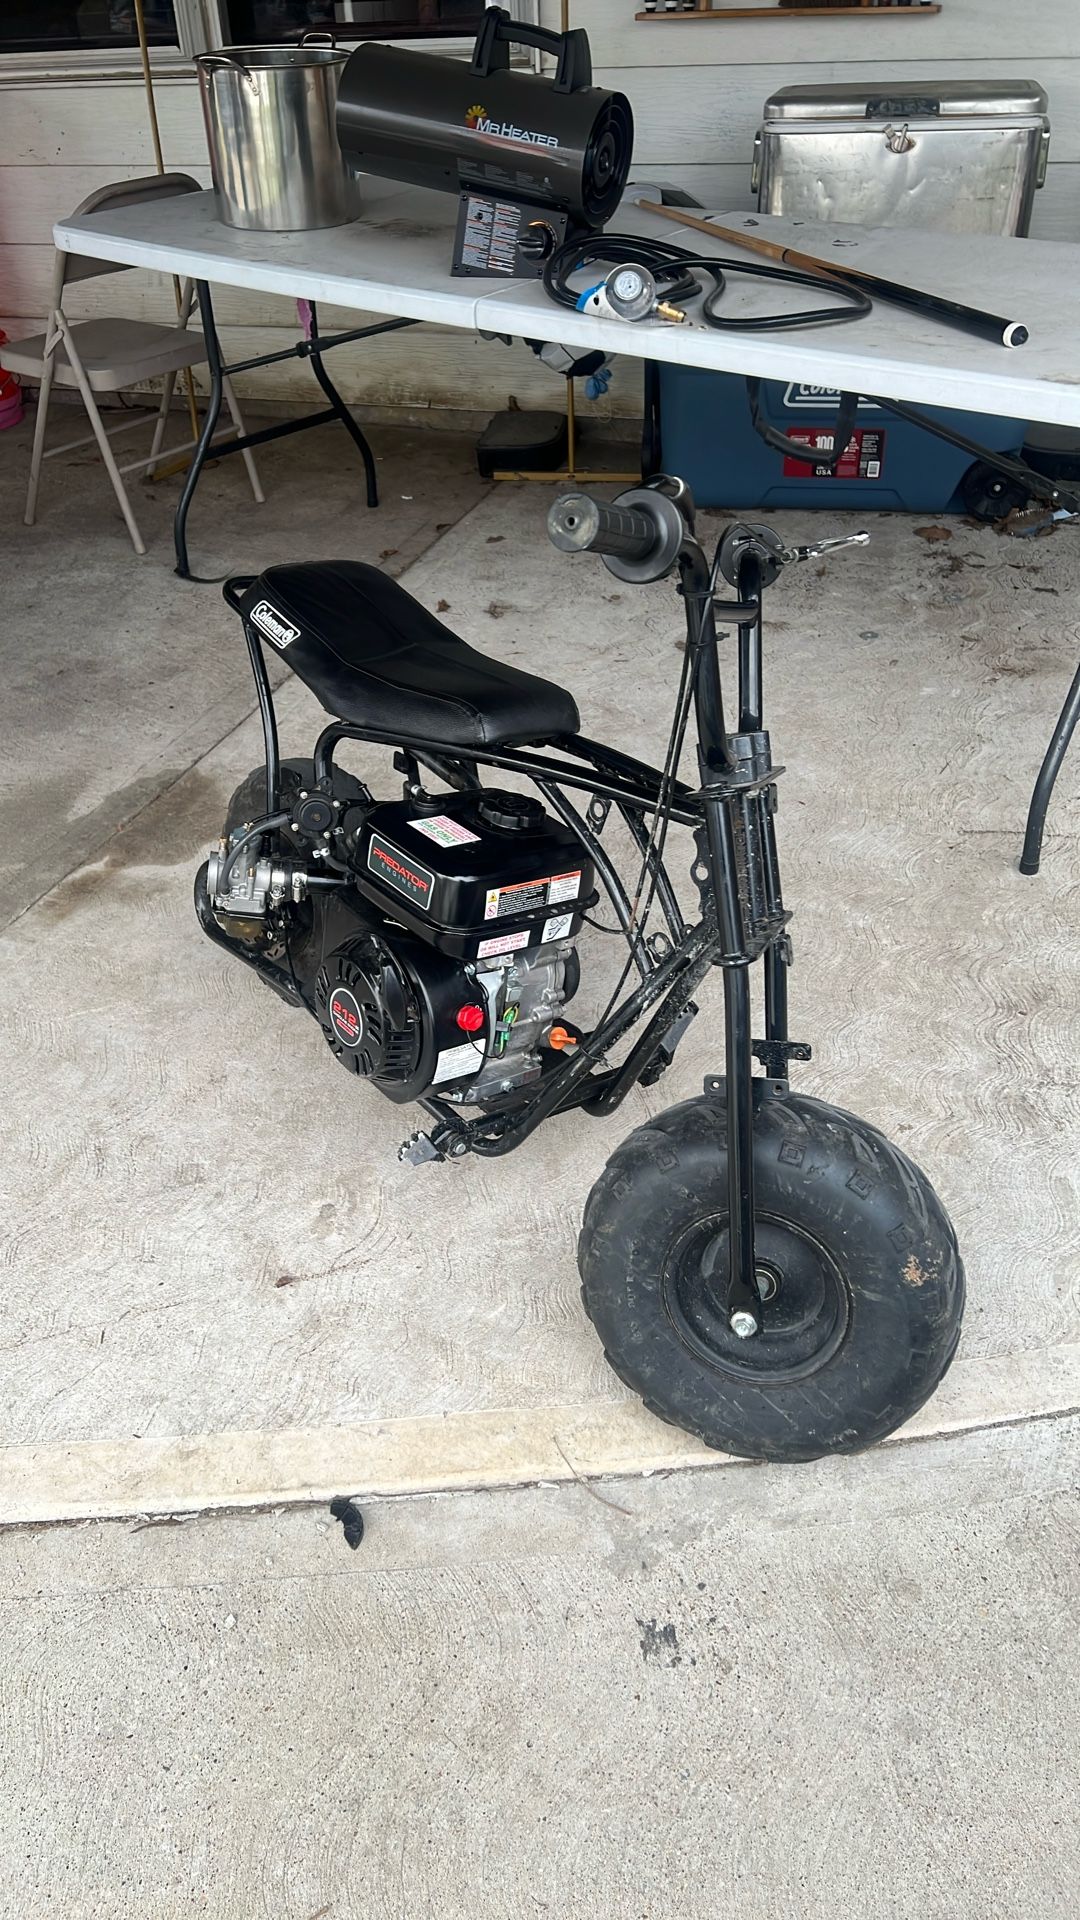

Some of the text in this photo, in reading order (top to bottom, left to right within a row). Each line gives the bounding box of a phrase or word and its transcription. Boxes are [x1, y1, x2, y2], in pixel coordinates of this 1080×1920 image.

[501, 122, 559, 149] HEATER
[255, 604, 287, 638] Coleman
[373, 846, 429, 893] PREDATOR
[381, 862, 417, 892] ENGINES
[333, 1000, 357, 1026] 212
